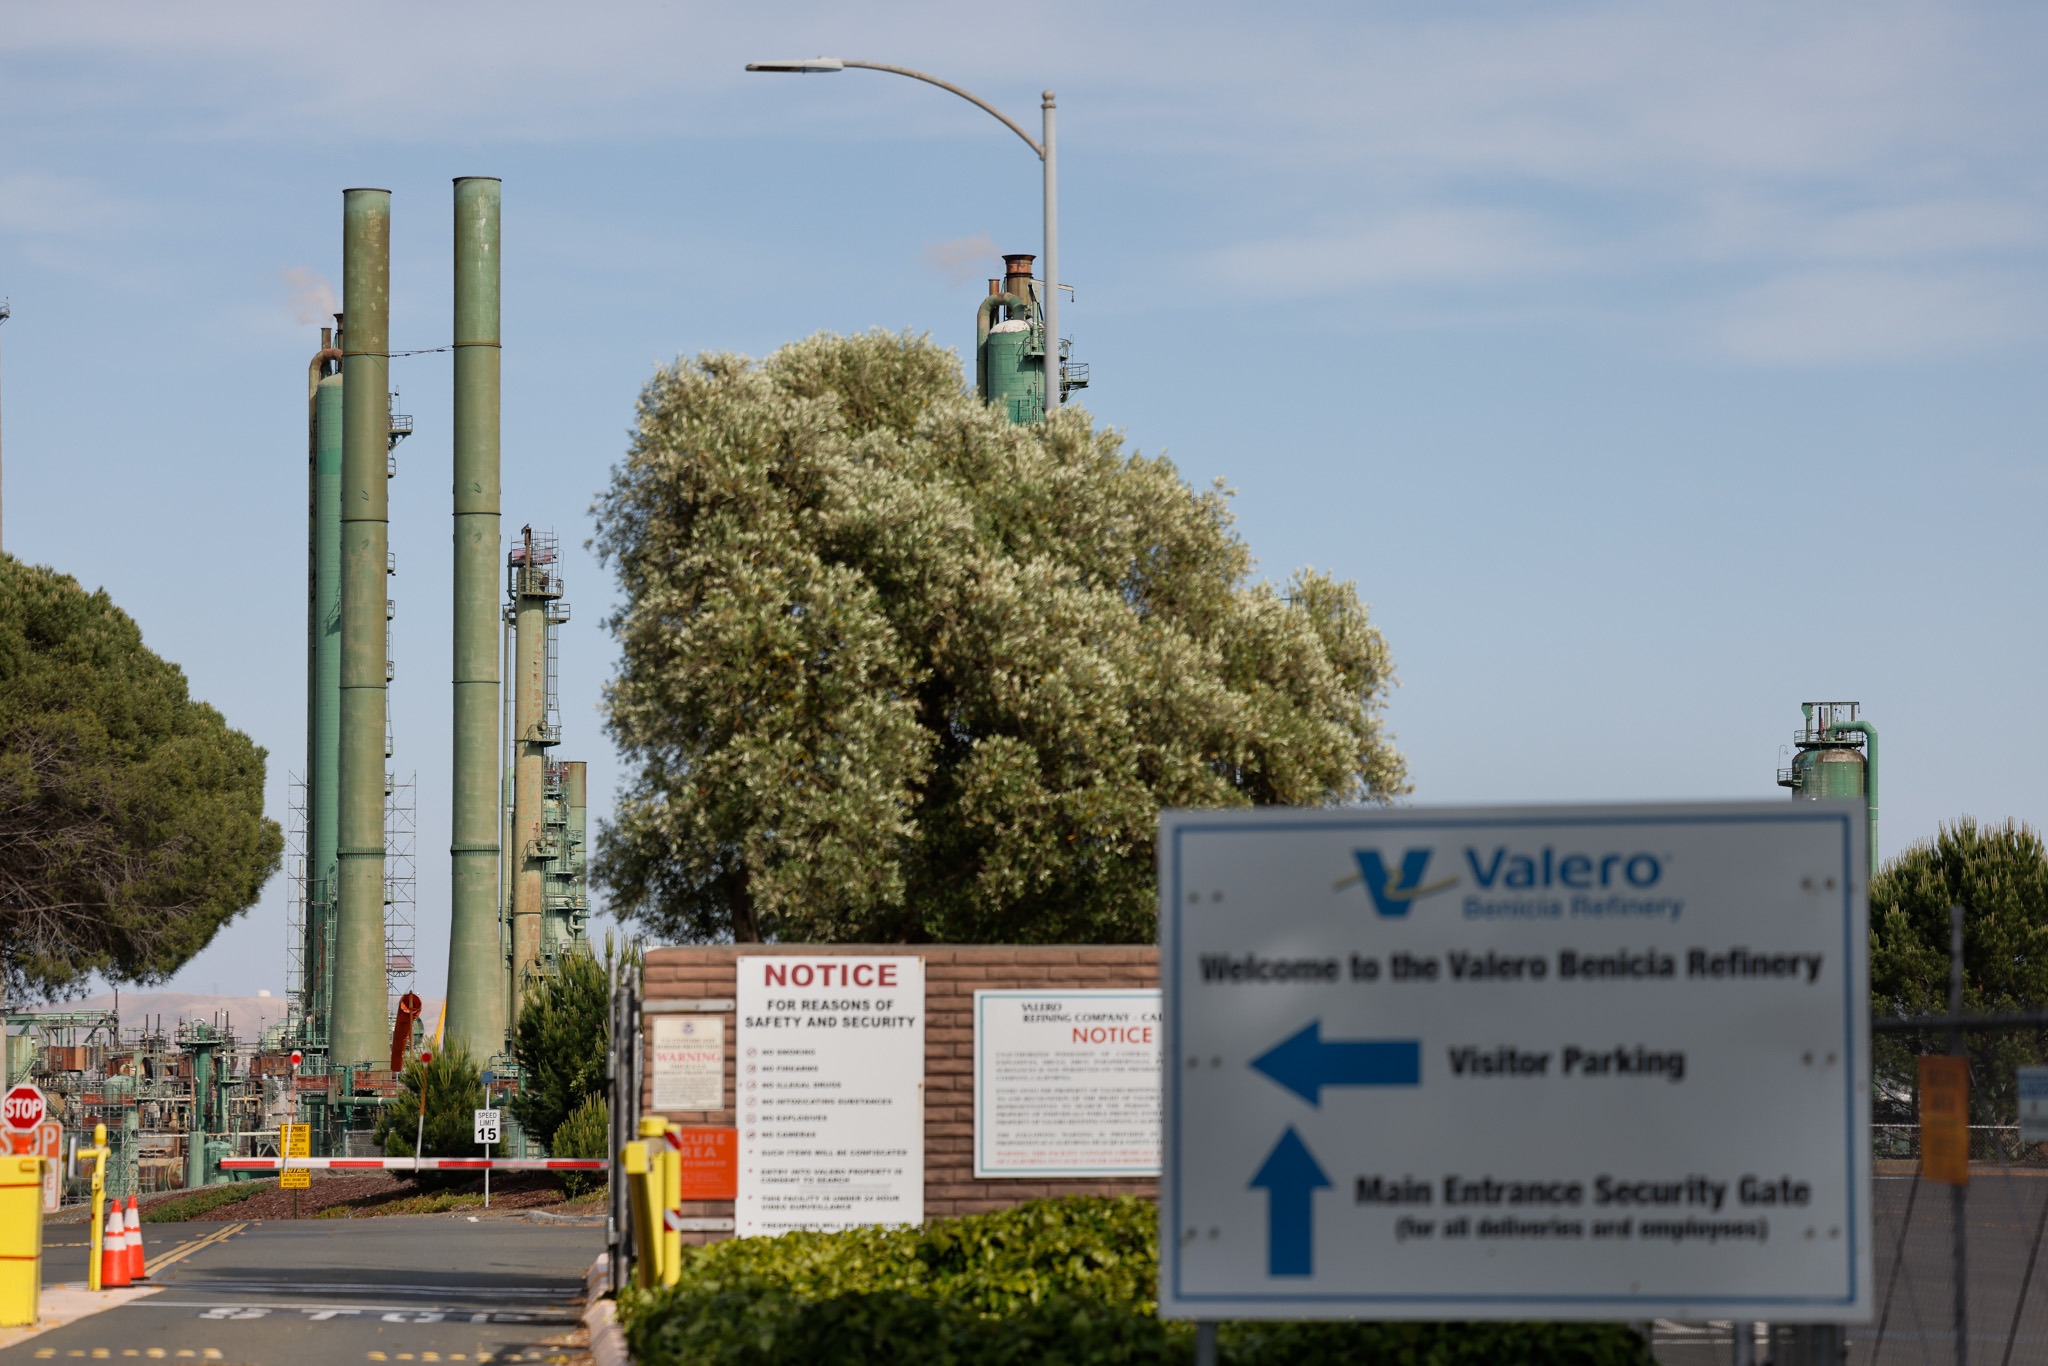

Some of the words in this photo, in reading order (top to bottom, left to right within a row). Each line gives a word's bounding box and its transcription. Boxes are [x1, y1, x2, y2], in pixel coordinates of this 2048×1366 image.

[1464, 846, 1662, 889] Valero
[1463, 895, 1562, 920] Benicia
[1571, 894, 1684, 923] Refinery
[764, 964, 898, 987] NOTICE
[1200, 953, 1339, 983] Welcome
[1351, 953, 1380, 982] to
[1390, 951, 1439, 982] the
[1449, 950, 1547, 981] Valero
[1558, 949, 1675, 979] Benicia
[1687, 948, 1823, 984] Refinery
[767, 1000, 796, 1011] FOR
[801, 1000, 870, 1012] REASONS
[876, 1000, 894, 1011] OF
[1075, 1012, 1129, 1021] COMPANY
[745, 1016, 801, 1028] SAFETY
[807, 1016, 837, 1028] AND
[842, 1016, 916, 1028] SECURITY
[1072, 1027, 1152, 1043] NOTICE
[656, 1052, 721, 1062] WARNING
[1449, 1045, 1550, 1076] Visitor
[1562, 1046, 1686, 1083] Parking
[5, 1098, 42, 1119] STOP
[0, 1127, 57, 1155] SOP
[478, 1128, 496, 1140] 15
[682, 1133, 726, 1145] CURE
[682, 1147, 717, 1158] REA
[1355, 1174, 1432, 1206] Main
[1444, 1174, 1584, 1206] Entrance
[1594, 1174, 1726, 1213] Security
[1738, 1174, 1811, 1206] Gate
[1395, 1217, 1436, 1244] (for
[1443, 1217, 1469, 1239] all
[1477, 1216, 1583, 1239] deliveries
[1591, 1216, 1632, 1239] and
[1641, 1216, 1769, 1244] employees)
